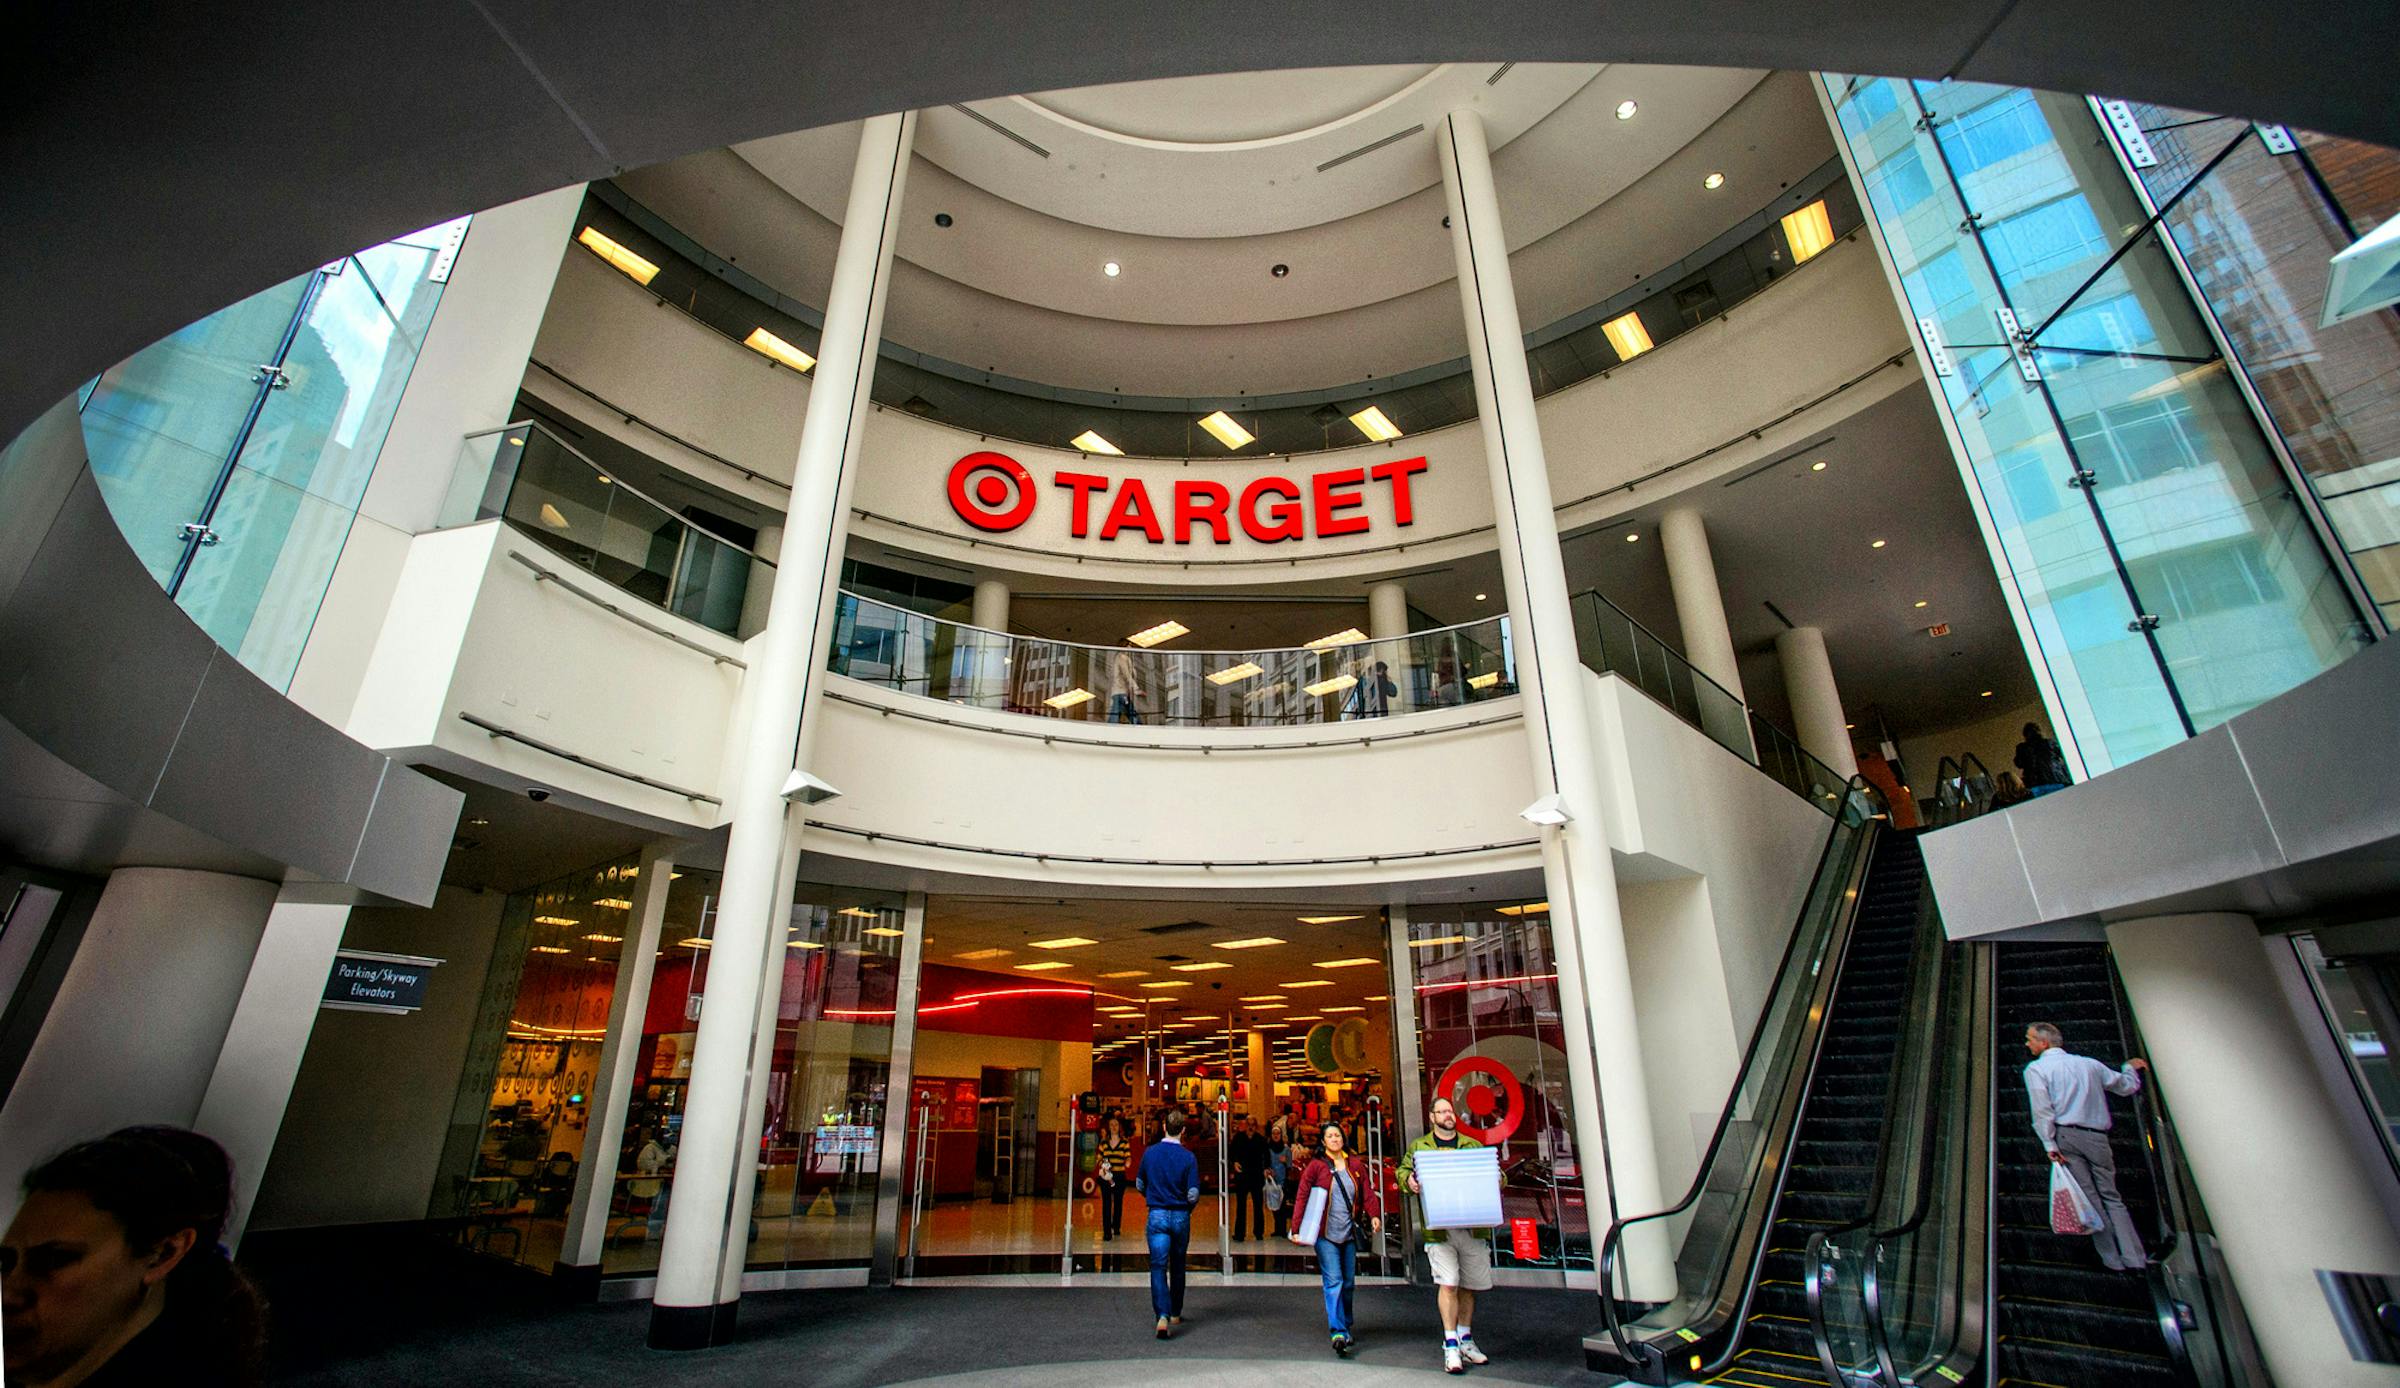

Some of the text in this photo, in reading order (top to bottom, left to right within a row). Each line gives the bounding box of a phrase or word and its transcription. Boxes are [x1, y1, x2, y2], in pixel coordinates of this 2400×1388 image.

[1054, 456, 1428, 545] TARGET
[1932, 623, 1947, 636] EXIT
[338, 963, 418, 986] Parking/Skyway
[350, 982, 396, 999] Elevators
